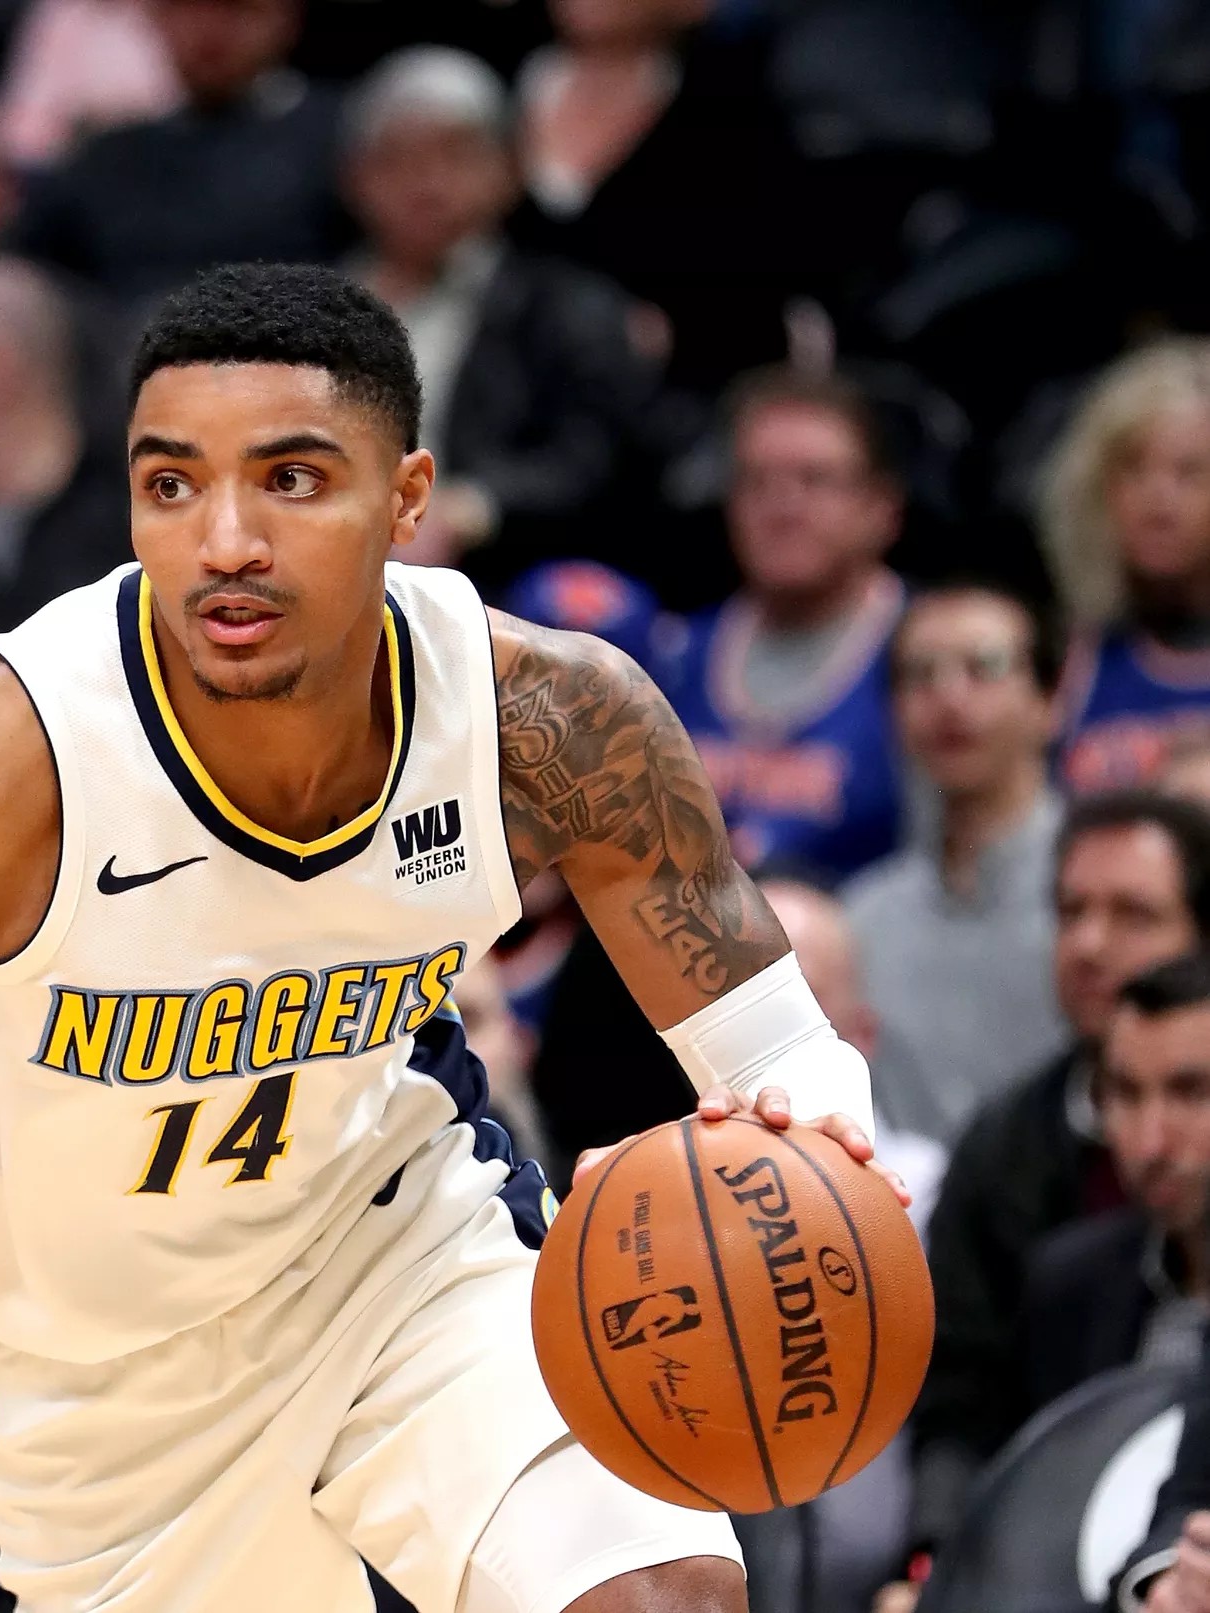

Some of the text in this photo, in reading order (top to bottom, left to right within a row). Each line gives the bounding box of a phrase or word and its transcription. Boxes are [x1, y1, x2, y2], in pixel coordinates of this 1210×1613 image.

[391, 799, 462, 862] WU
[395, 845, 465, 880] WESTERN
[415, 859, 466, 885] UNION
[28, 941, 468, 1087] NUGGETS
[123, 1071, 298, 1197] 14
[634, 1190, 656, 1286] OFFICIAL GAME BALL
[603, 1307, 623, 1340] NBA
[714, 1156, 838, 1424] SPALDING
